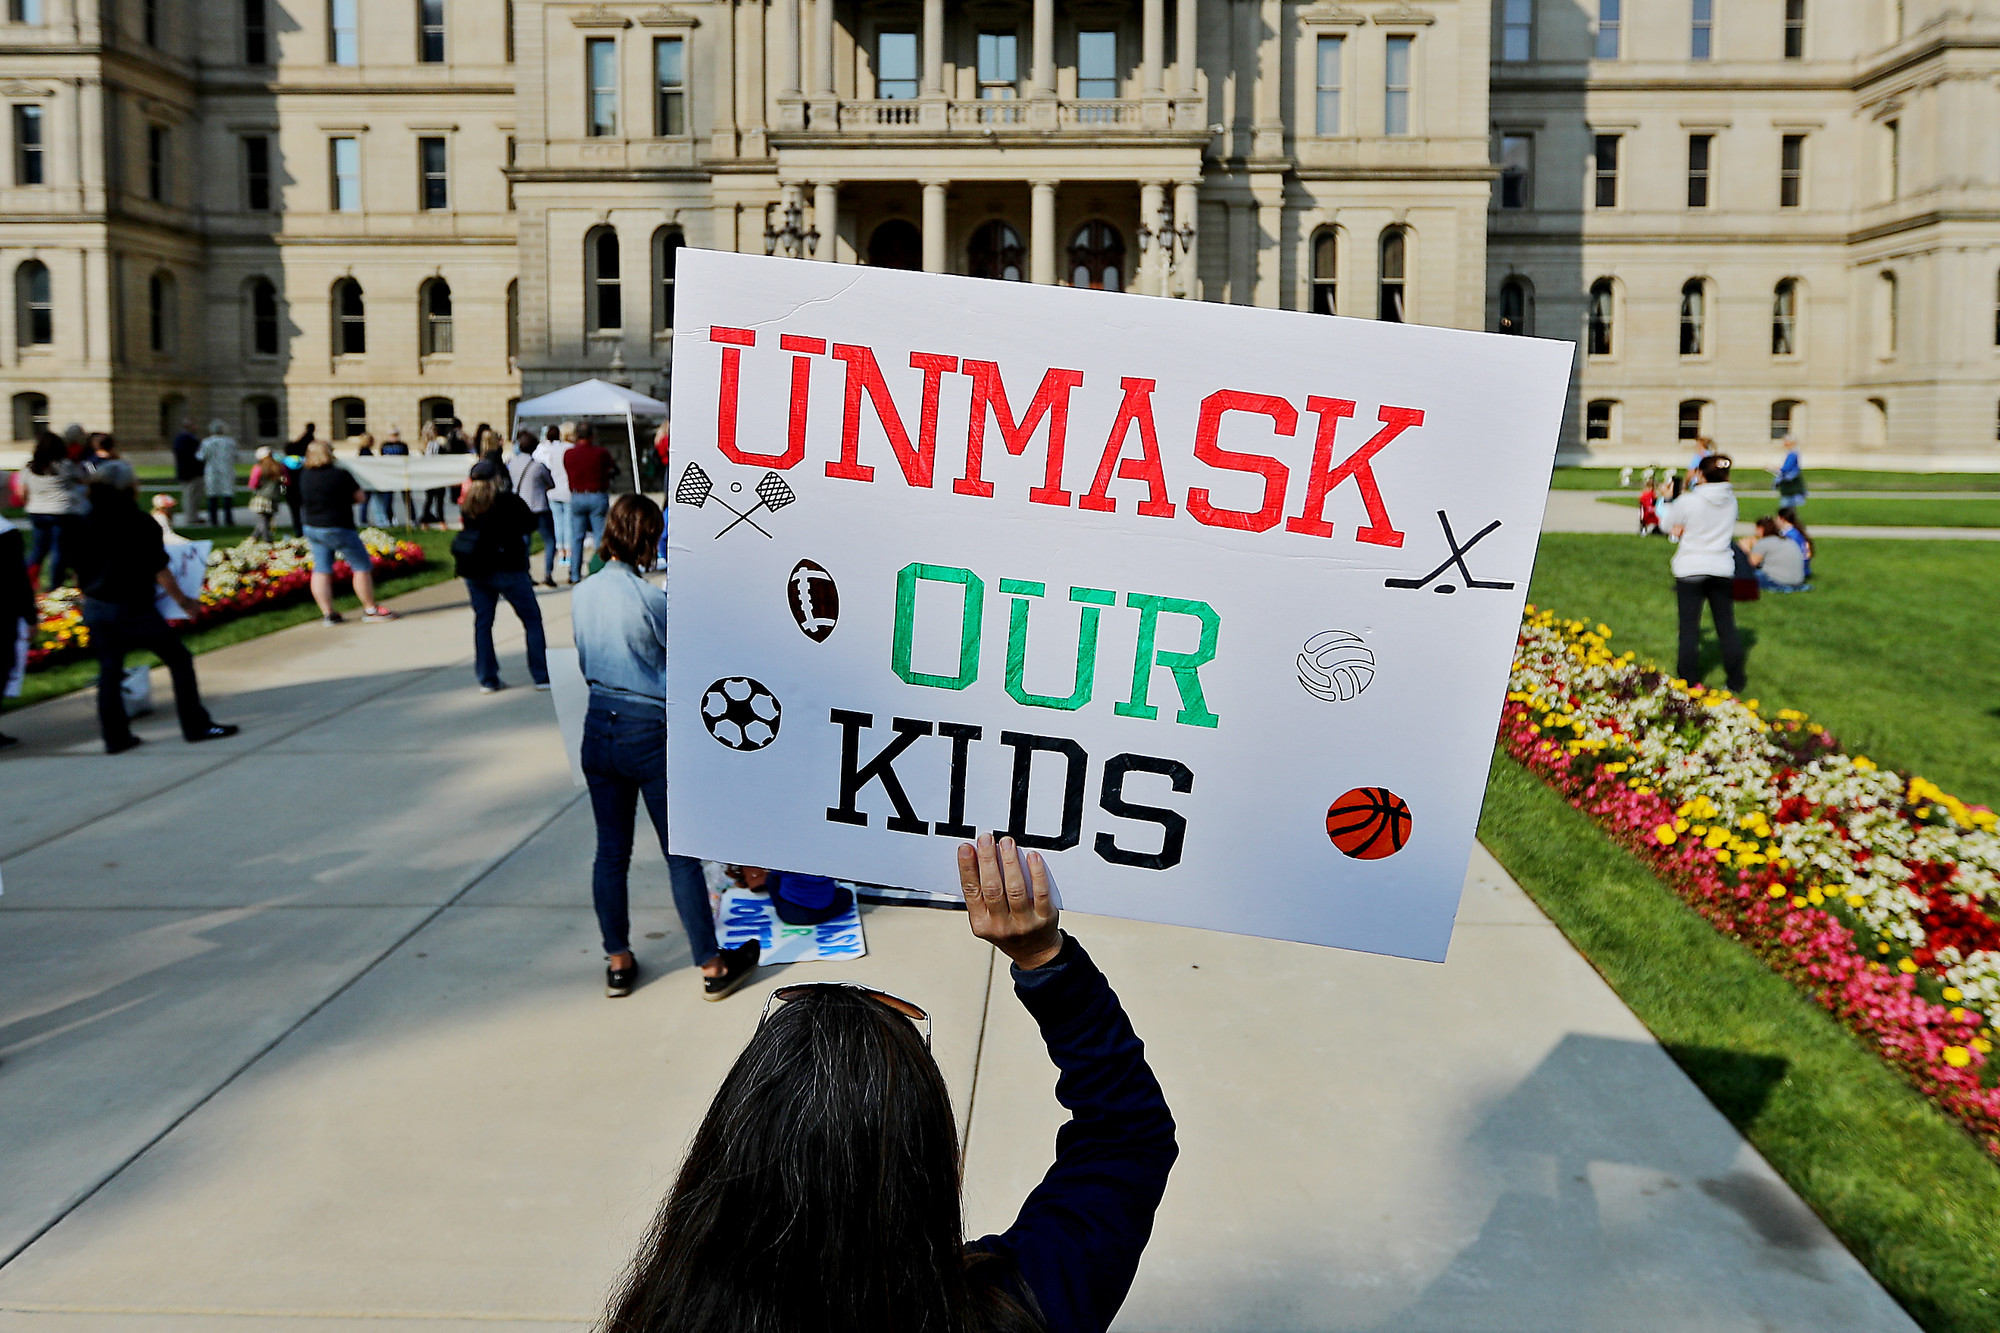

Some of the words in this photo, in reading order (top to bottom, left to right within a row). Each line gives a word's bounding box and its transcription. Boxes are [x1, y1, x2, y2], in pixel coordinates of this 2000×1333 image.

[710, 326, 1425, 548] UNMASK
[892, 563, 1221, 728] OUR
[826, 708, 1195, 872] KIDS
